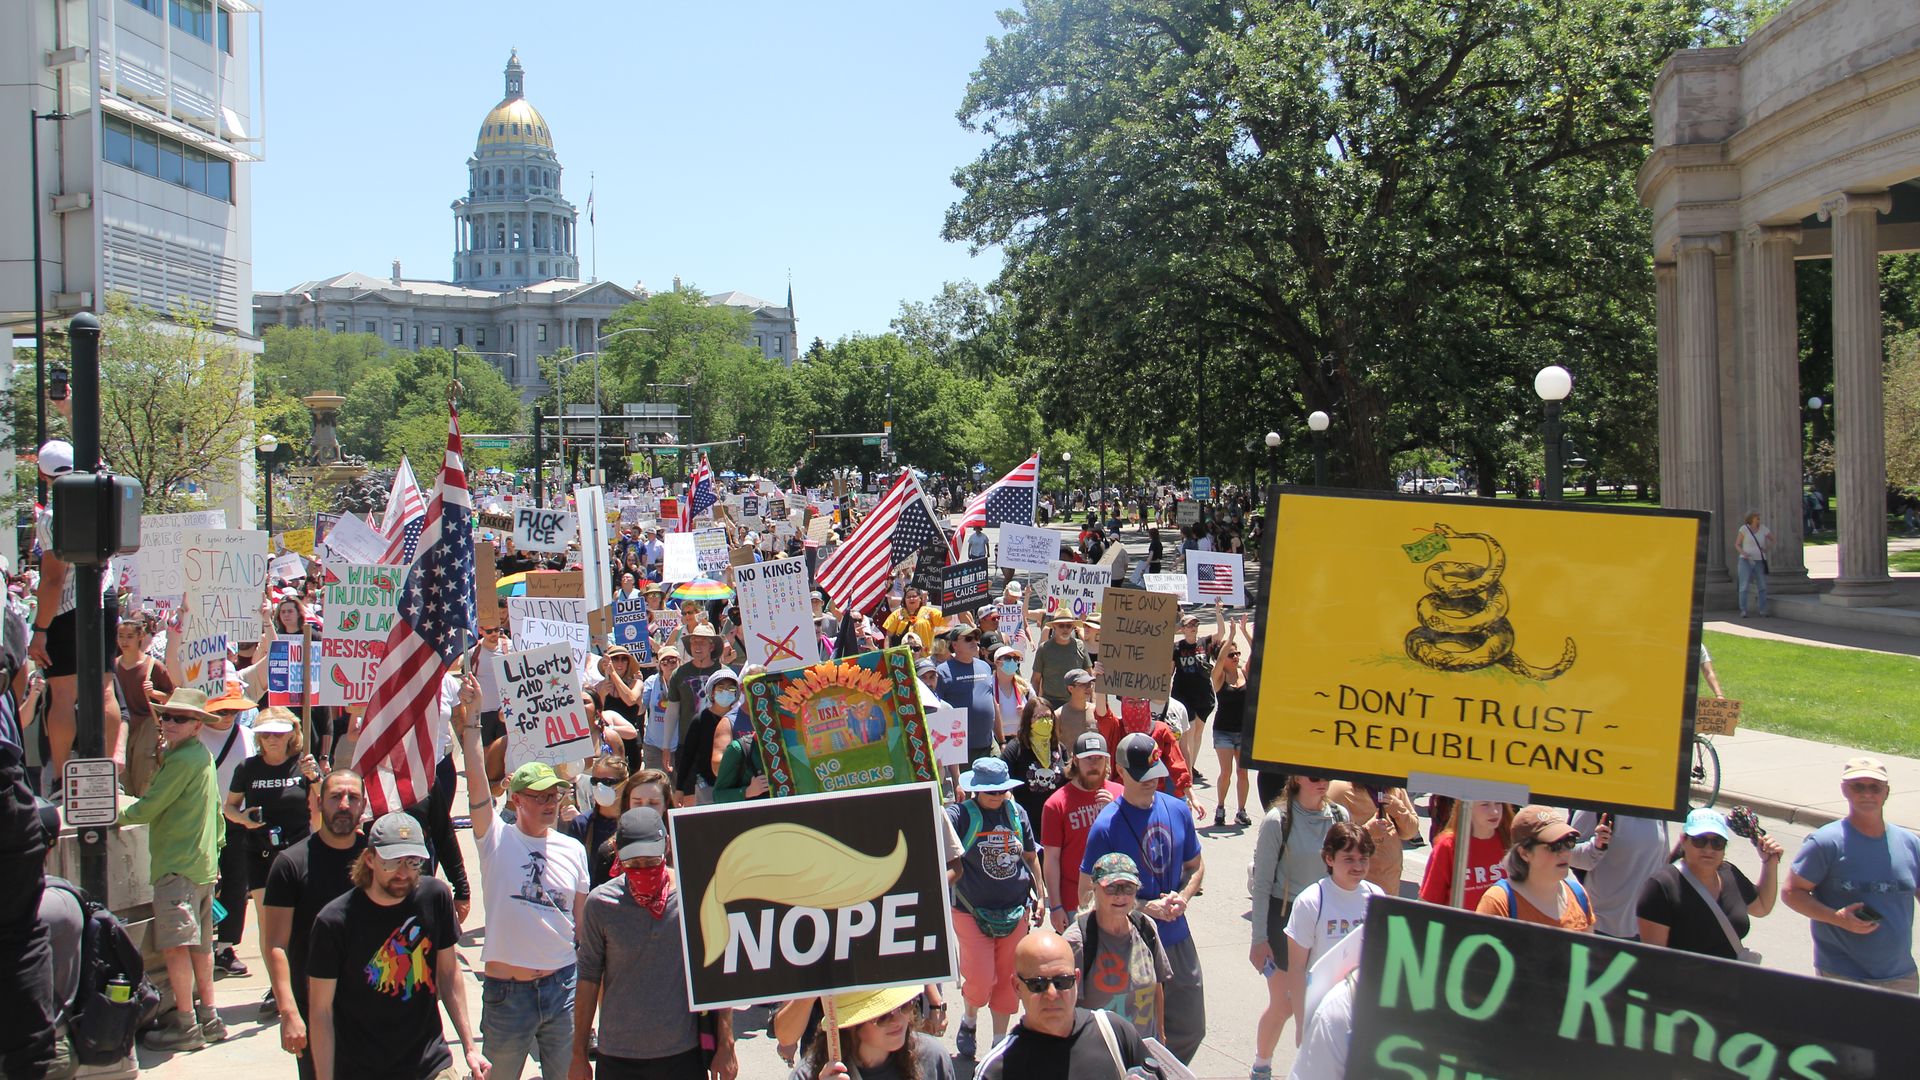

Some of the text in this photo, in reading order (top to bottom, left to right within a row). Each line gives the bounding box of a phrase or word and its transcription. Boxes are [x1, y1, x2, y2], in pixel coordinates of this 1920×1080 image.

[519, 510, 564, 531] FUCK
[208, 536, 222, 548] you
[225, 535, 246, 544] don't
[527, 528, 555, 544] ICE
[185, 548, 265, 587] STAND
[698, 560, 729, 571] NO KINGS
[738, 561, 801, 582] NO KINGS
[348, 566, 402, 586] WHEN
[944, 570, 987, 589] ARE WE GREAT YET?
[1079, 567, 1111, 585] ROYALTY
[327, 583, 404, 607] INJUSTIC
[953, 585, 978, 597] 'CAUSE
[1051, 585, 1094, 598] WE WANT ARE
[156, 600, 171, 609] NOW
[201, 594, 252, 619] FALL
[510, 600, 583, 624] SILENCE
[617, 600, 641, 613] DUE
[1109, 592, 1167, 612] THE ONLY
[185, 614, 259, 642] ANYTHING
[338, 609, 360, 631] IS
[615, 613, 645, 624] PROCESS
[526, 621, 585, 642] IF YOU'RE
[188, 634, 227, 660] CROWN
[290, 645, 302, 663] NO
[631, 641, 645, 650] THE
[1102, 644, 1145, 660] IN THE
[630, 652, 647, 663] AW
[361, 662, 380, 680] IS
[504, 653, 572, 683] Liberty
[343, 682, 374, 701] DUT
[517, 678, 543, 698] AND
[527, 691, 575, 714] Justice
[1338, 684, 1593, 735] DON'T TRUST
[818, 705, 840, 721] USA
[515, 712, 590, 746] for ALL
[751, 682, 791, 797] GREEDIES
[1333, 720, 1605, 776] REPUBLICANS
[905, 720, 930, 780] EART
[815, 759, 841, 780] NO
[823, 765, 895, 792] CHECKS
[252, 777, 302, 789] #RESIST
[723, 892, 937, 974] NOPE.
[1378, 915, 1838, 1080] NO Kings
